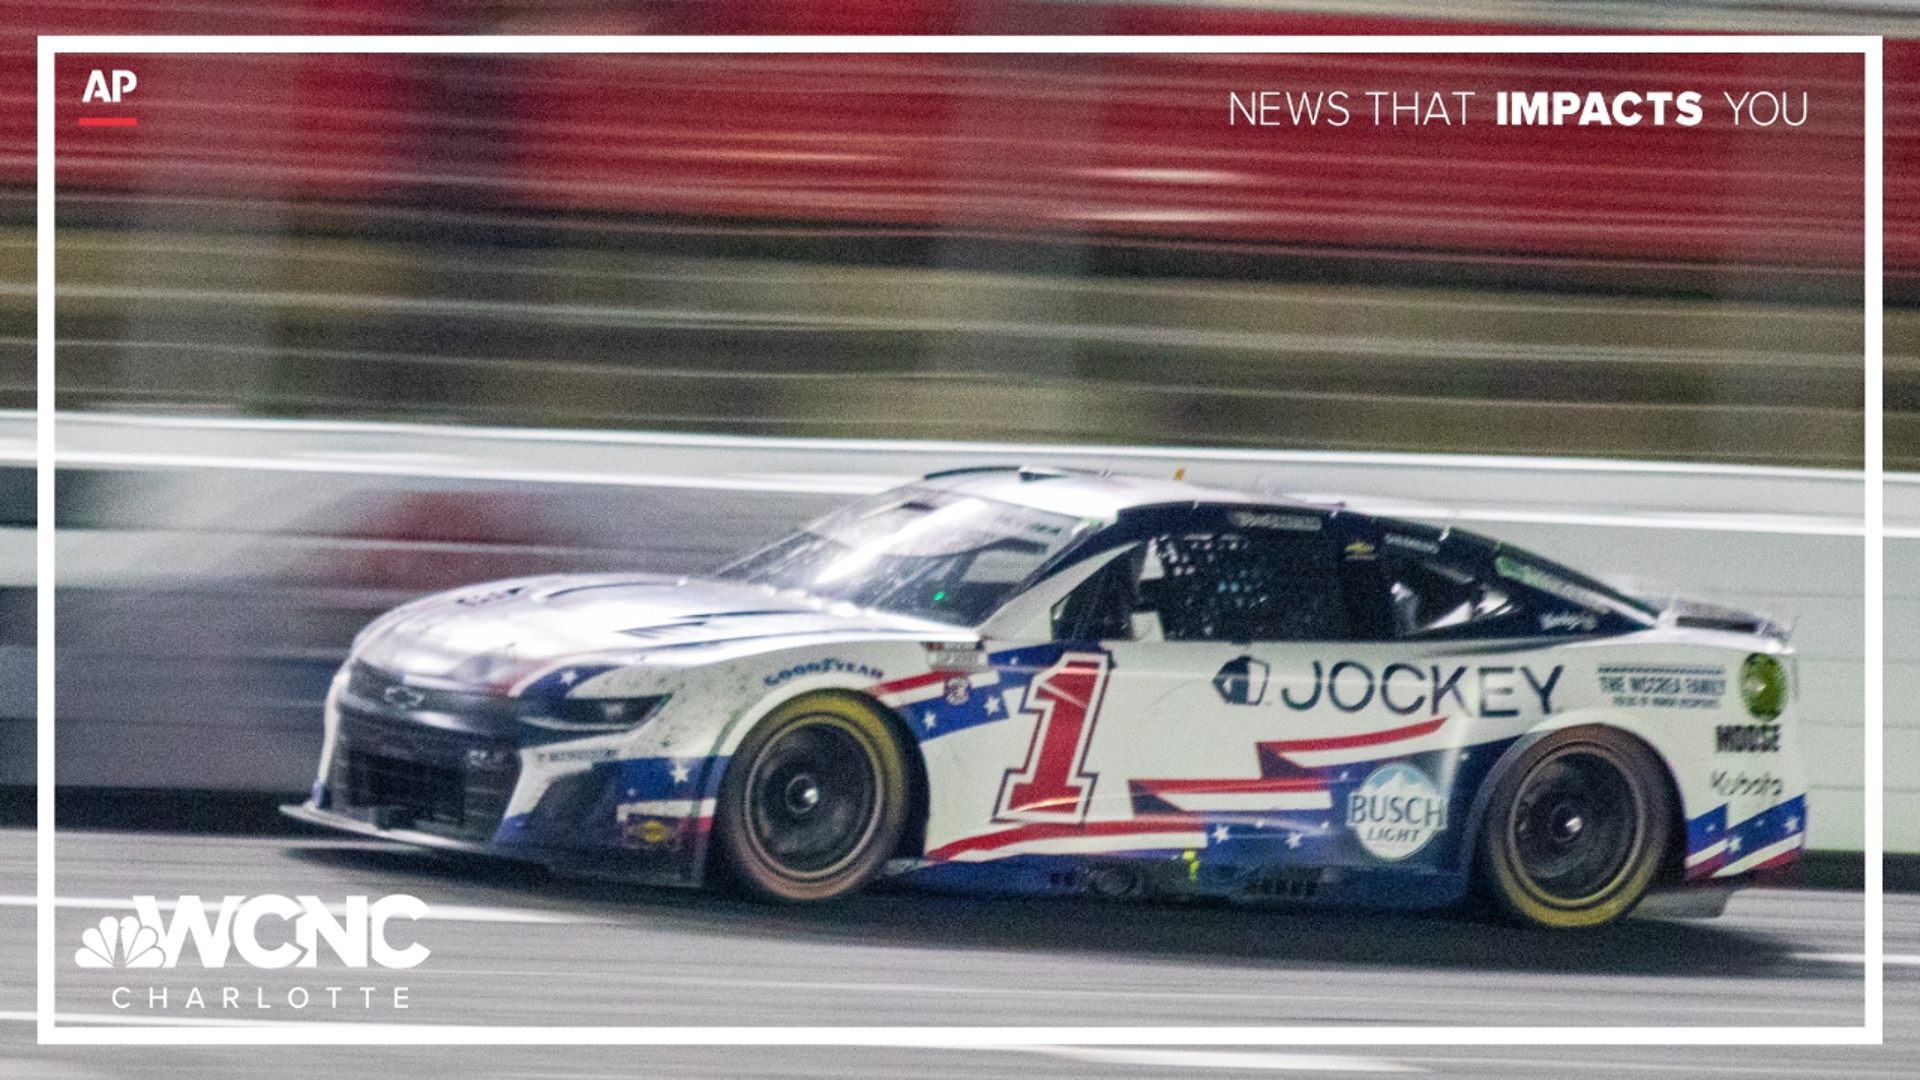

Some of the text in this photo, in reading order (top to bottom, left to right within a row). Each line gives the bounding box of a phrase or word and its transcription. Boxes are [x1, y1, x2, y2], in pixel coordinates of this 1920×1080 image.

[764, 657, 885, 686] GOODYEAR
[1281, 660, 1565, 717] JOCKEY
[990, 651, 1117, 827] 1
[1716, 724, 1781, 752] MOOSE
[1711, 771, 1784, 796] Kubota
[1350, 794, 1444, 827] BUSCH
[1366, 827, 1420, 842] LIGHT
